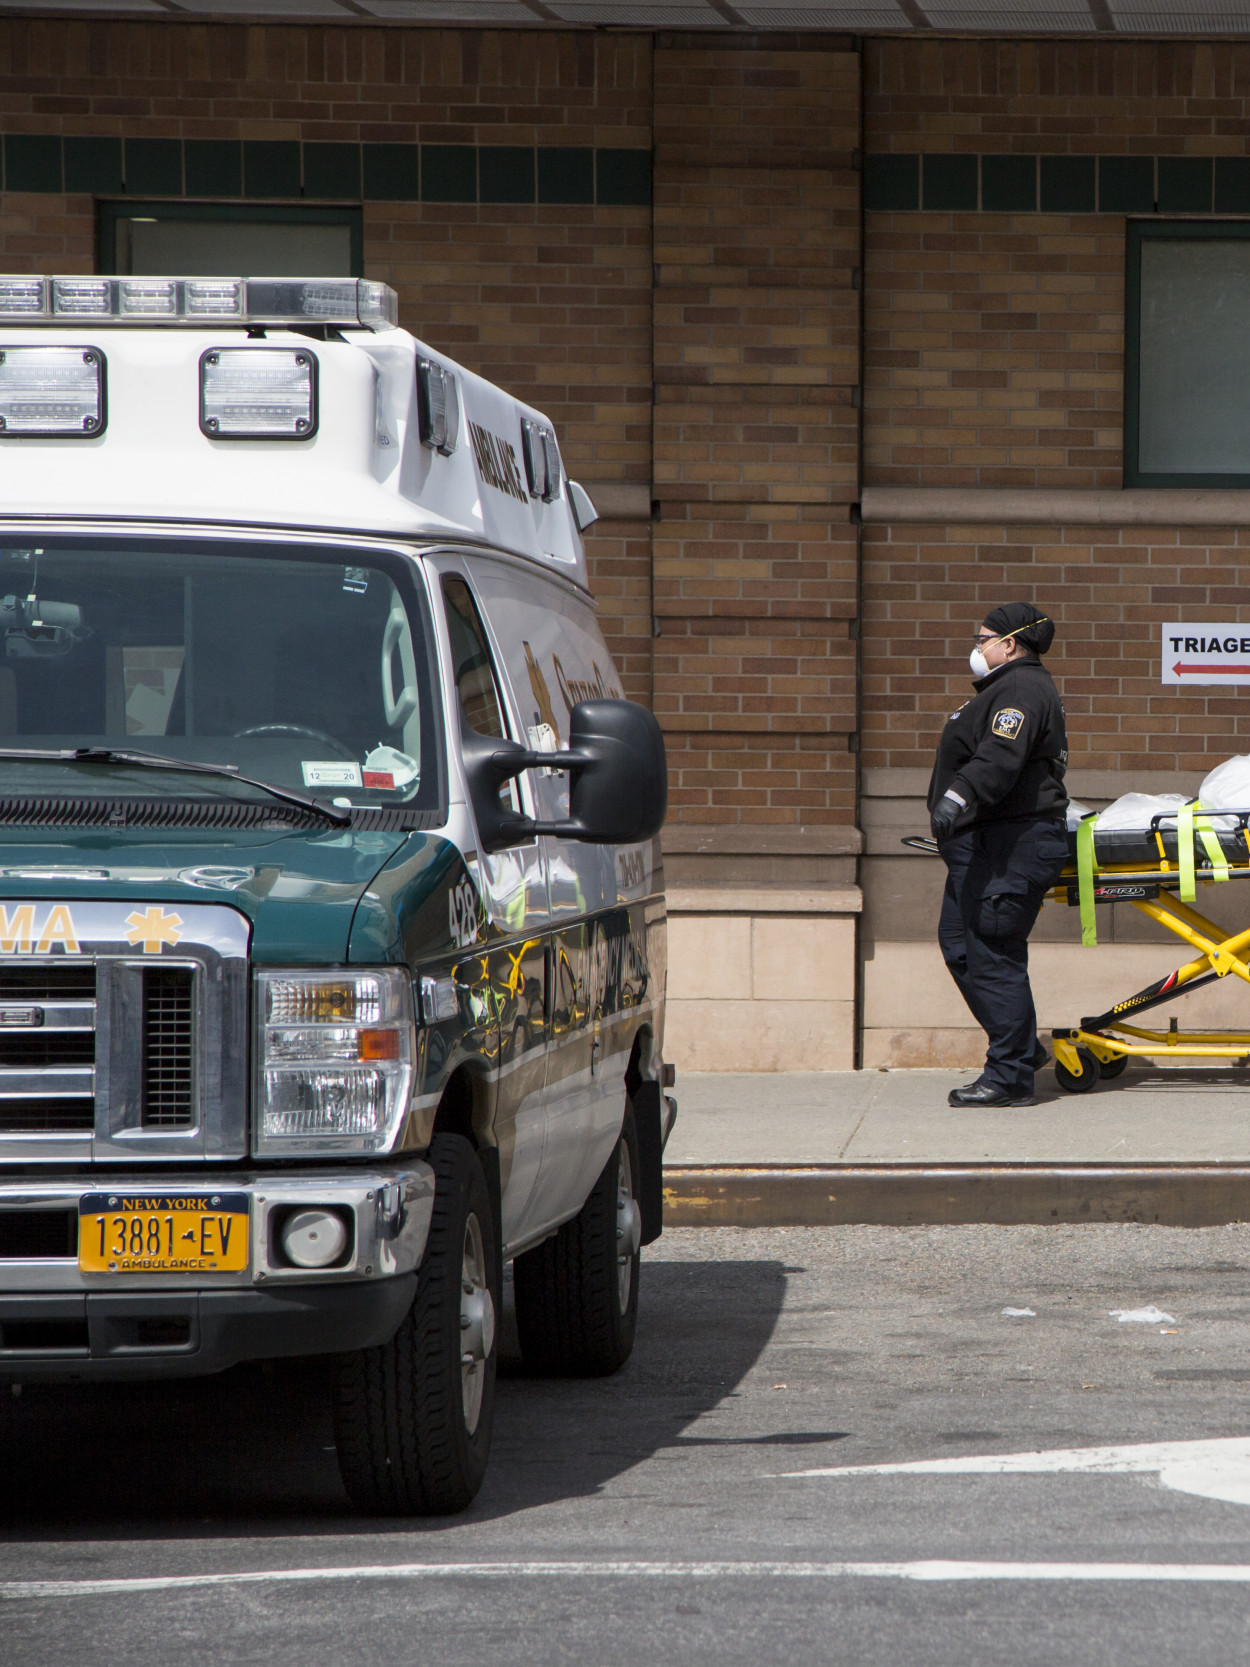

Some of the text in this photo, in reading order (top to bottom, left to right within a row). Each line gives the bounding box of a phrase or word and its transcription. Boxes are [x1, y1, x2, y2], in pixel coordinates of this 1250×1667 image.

[309, 772, 321, 780] 12
[448, 882, 478, 949] 428
[122, 1198, 209, 1211] NEW YORK
[96, 1215, 232, 1257] 13881 EV
[121, 1258, 207, 1270] AMBULANCE
